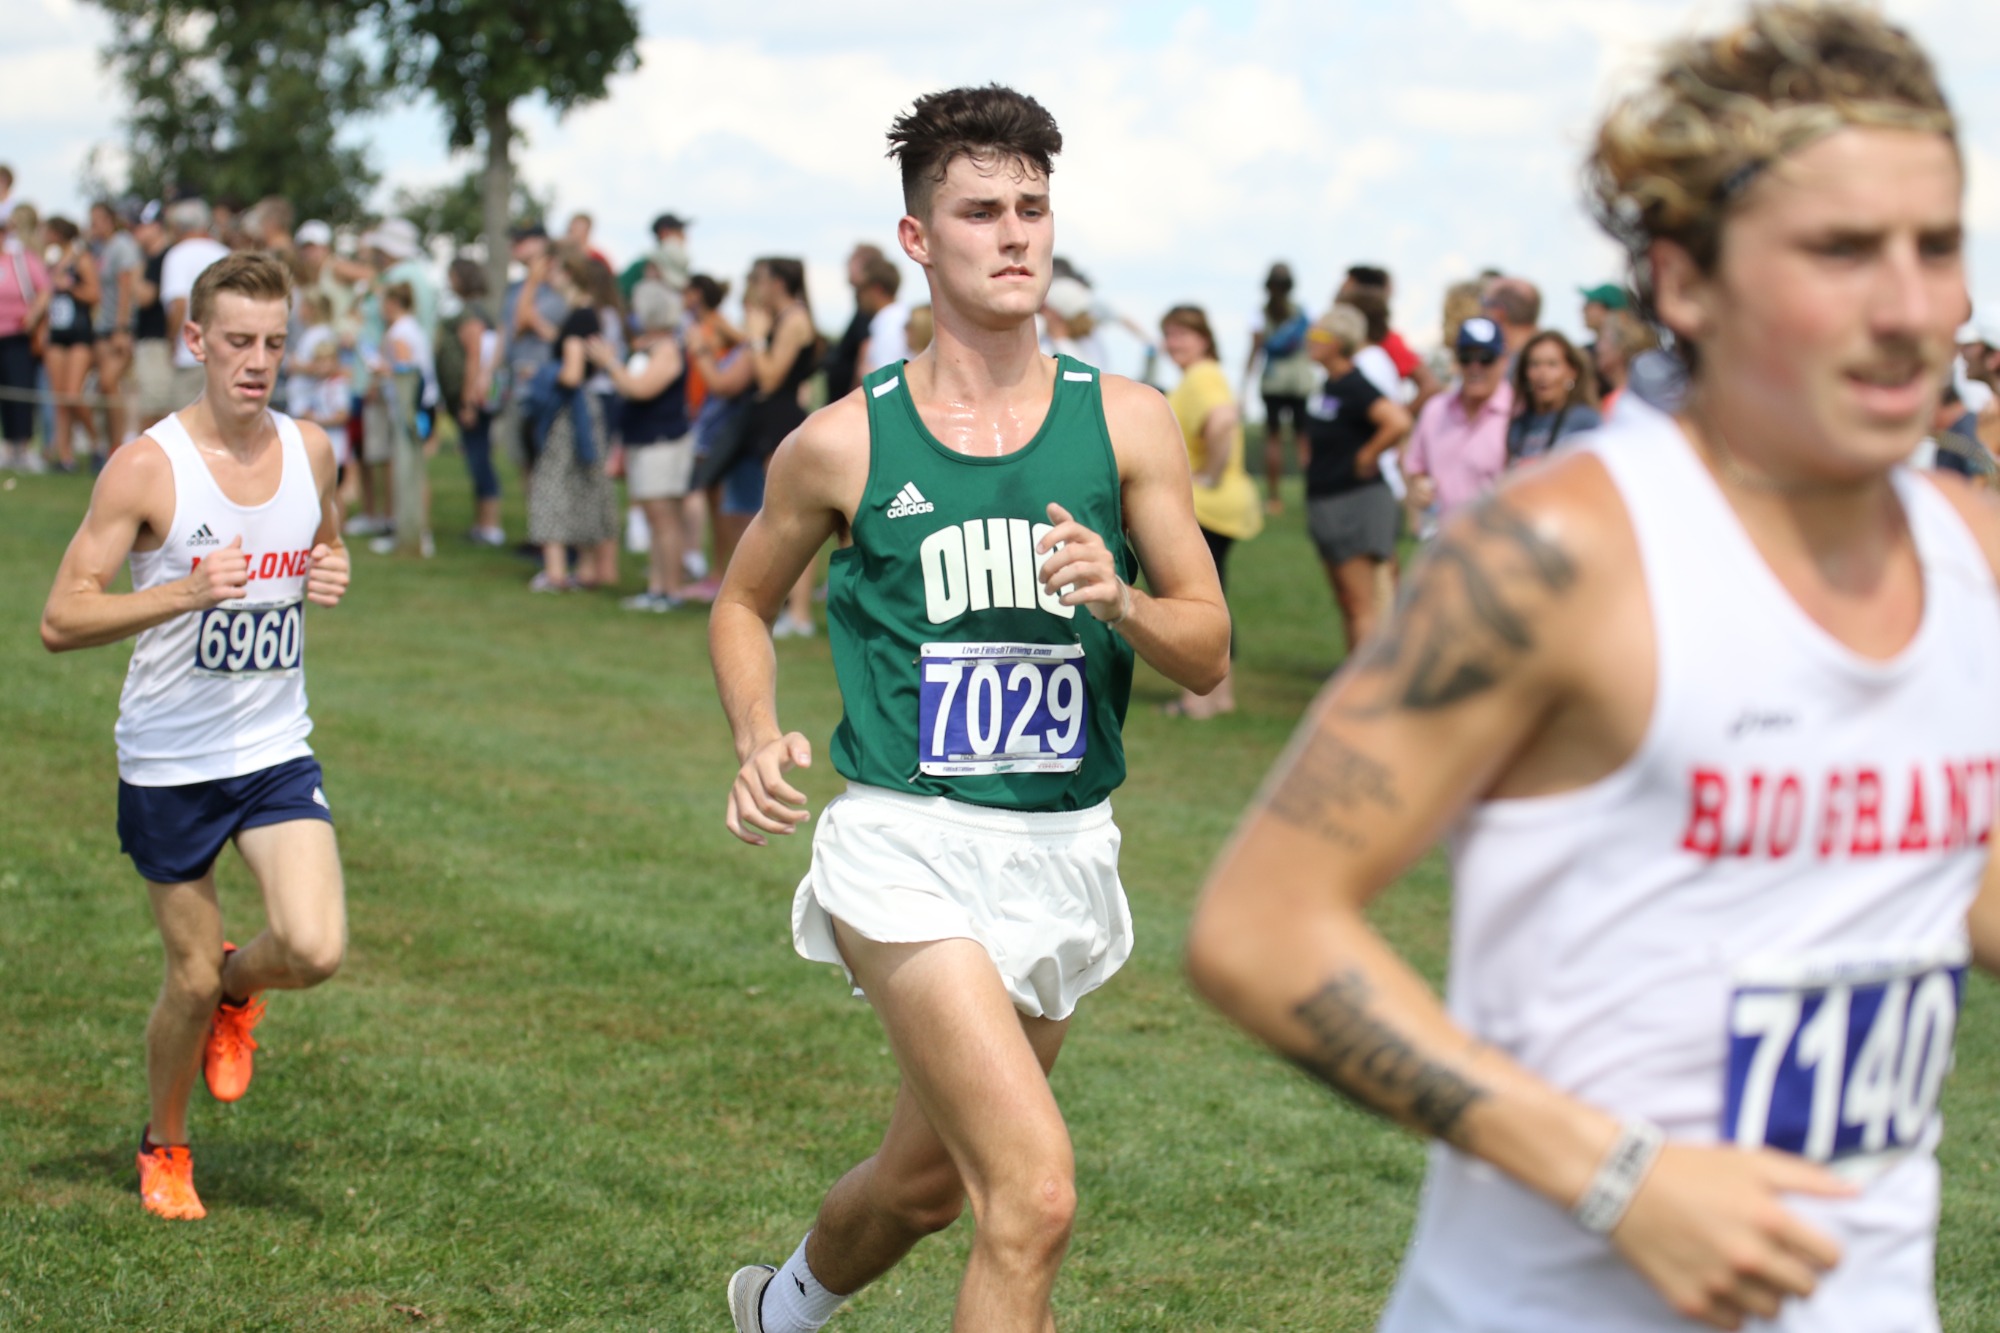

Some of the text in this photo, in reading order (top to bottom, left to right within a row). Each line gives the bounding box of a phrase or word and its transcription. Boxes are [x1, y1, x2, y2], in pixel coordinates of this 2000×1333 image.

[186, 537, 220, 547] adidas
[887, 502, 935, 519] adidas
[200, 605, 301, 672] 6960
[925, 662, 1084, 757] 7029
[1733, 967, 1957, 1163] 7140
